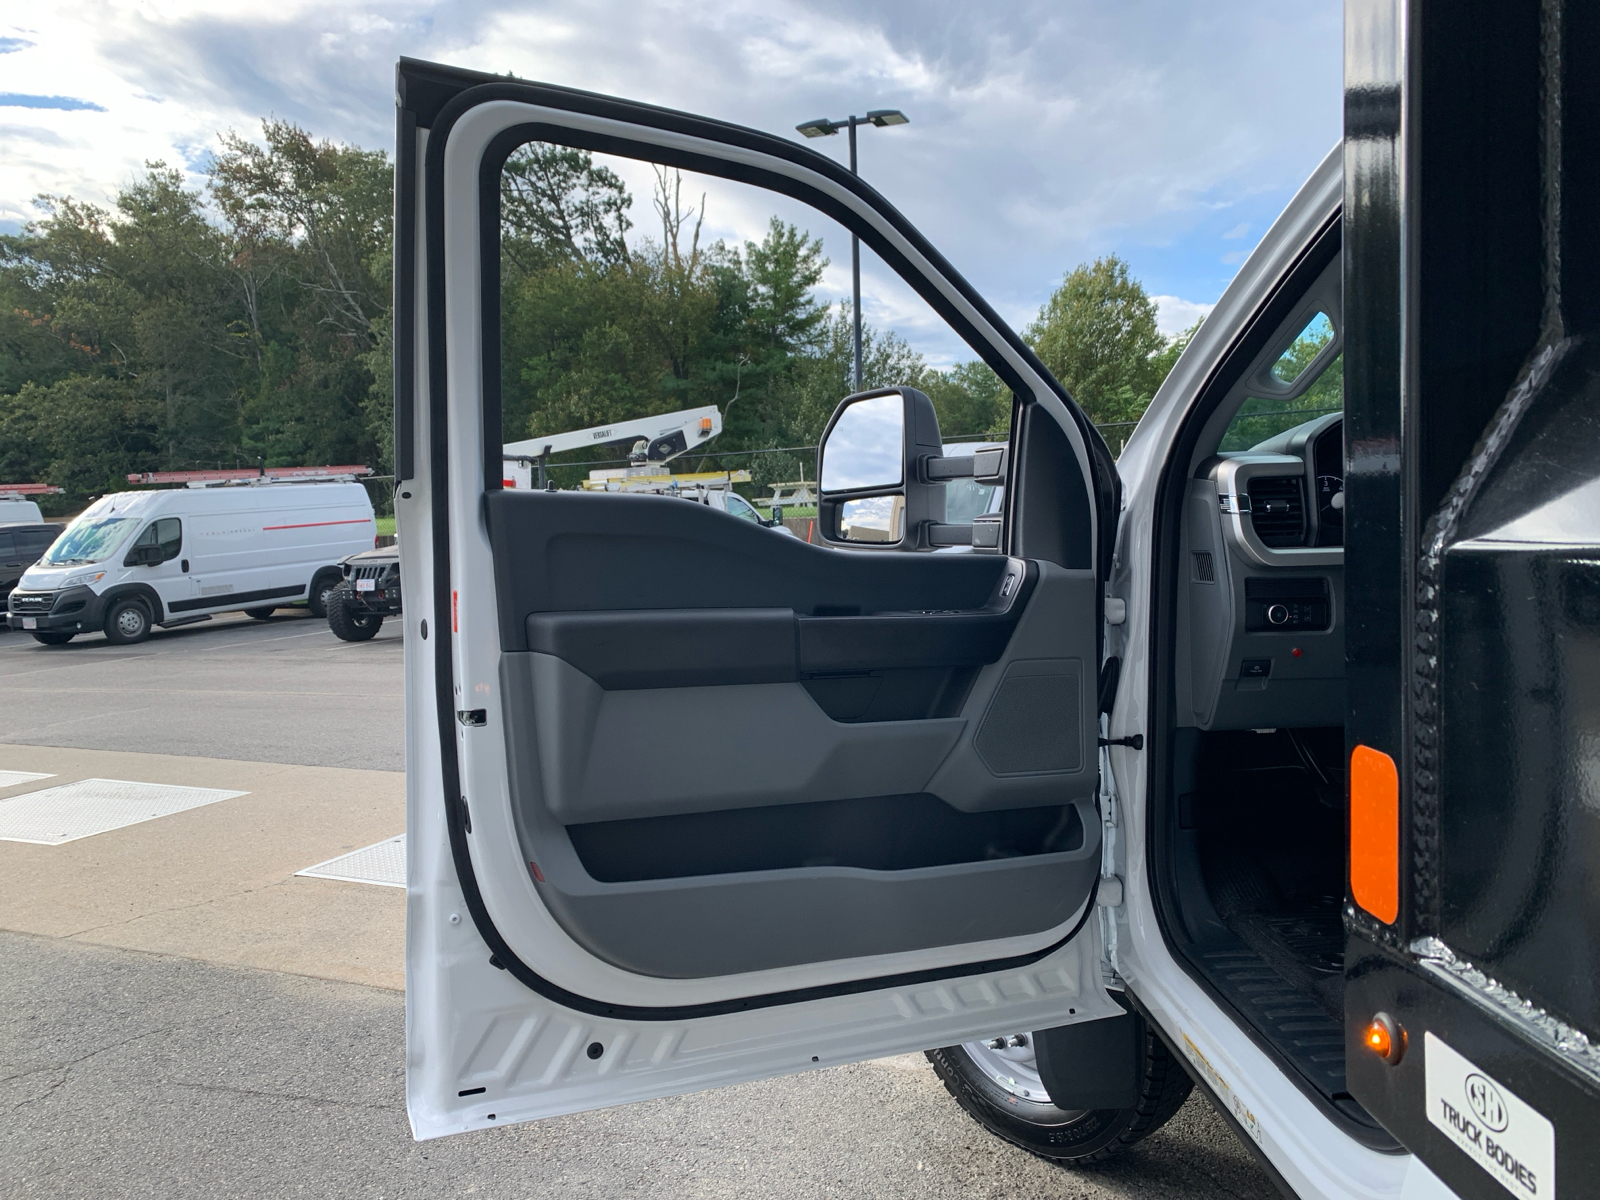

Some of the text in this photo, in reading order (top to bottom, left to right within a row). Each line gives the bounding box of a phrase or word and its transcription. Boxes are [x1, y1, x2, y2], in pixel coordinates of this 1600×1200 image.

[593, 430, 612, 439] VERSALIFT
[1441, 1098, 1537, 1195] TRUCK BODIES
